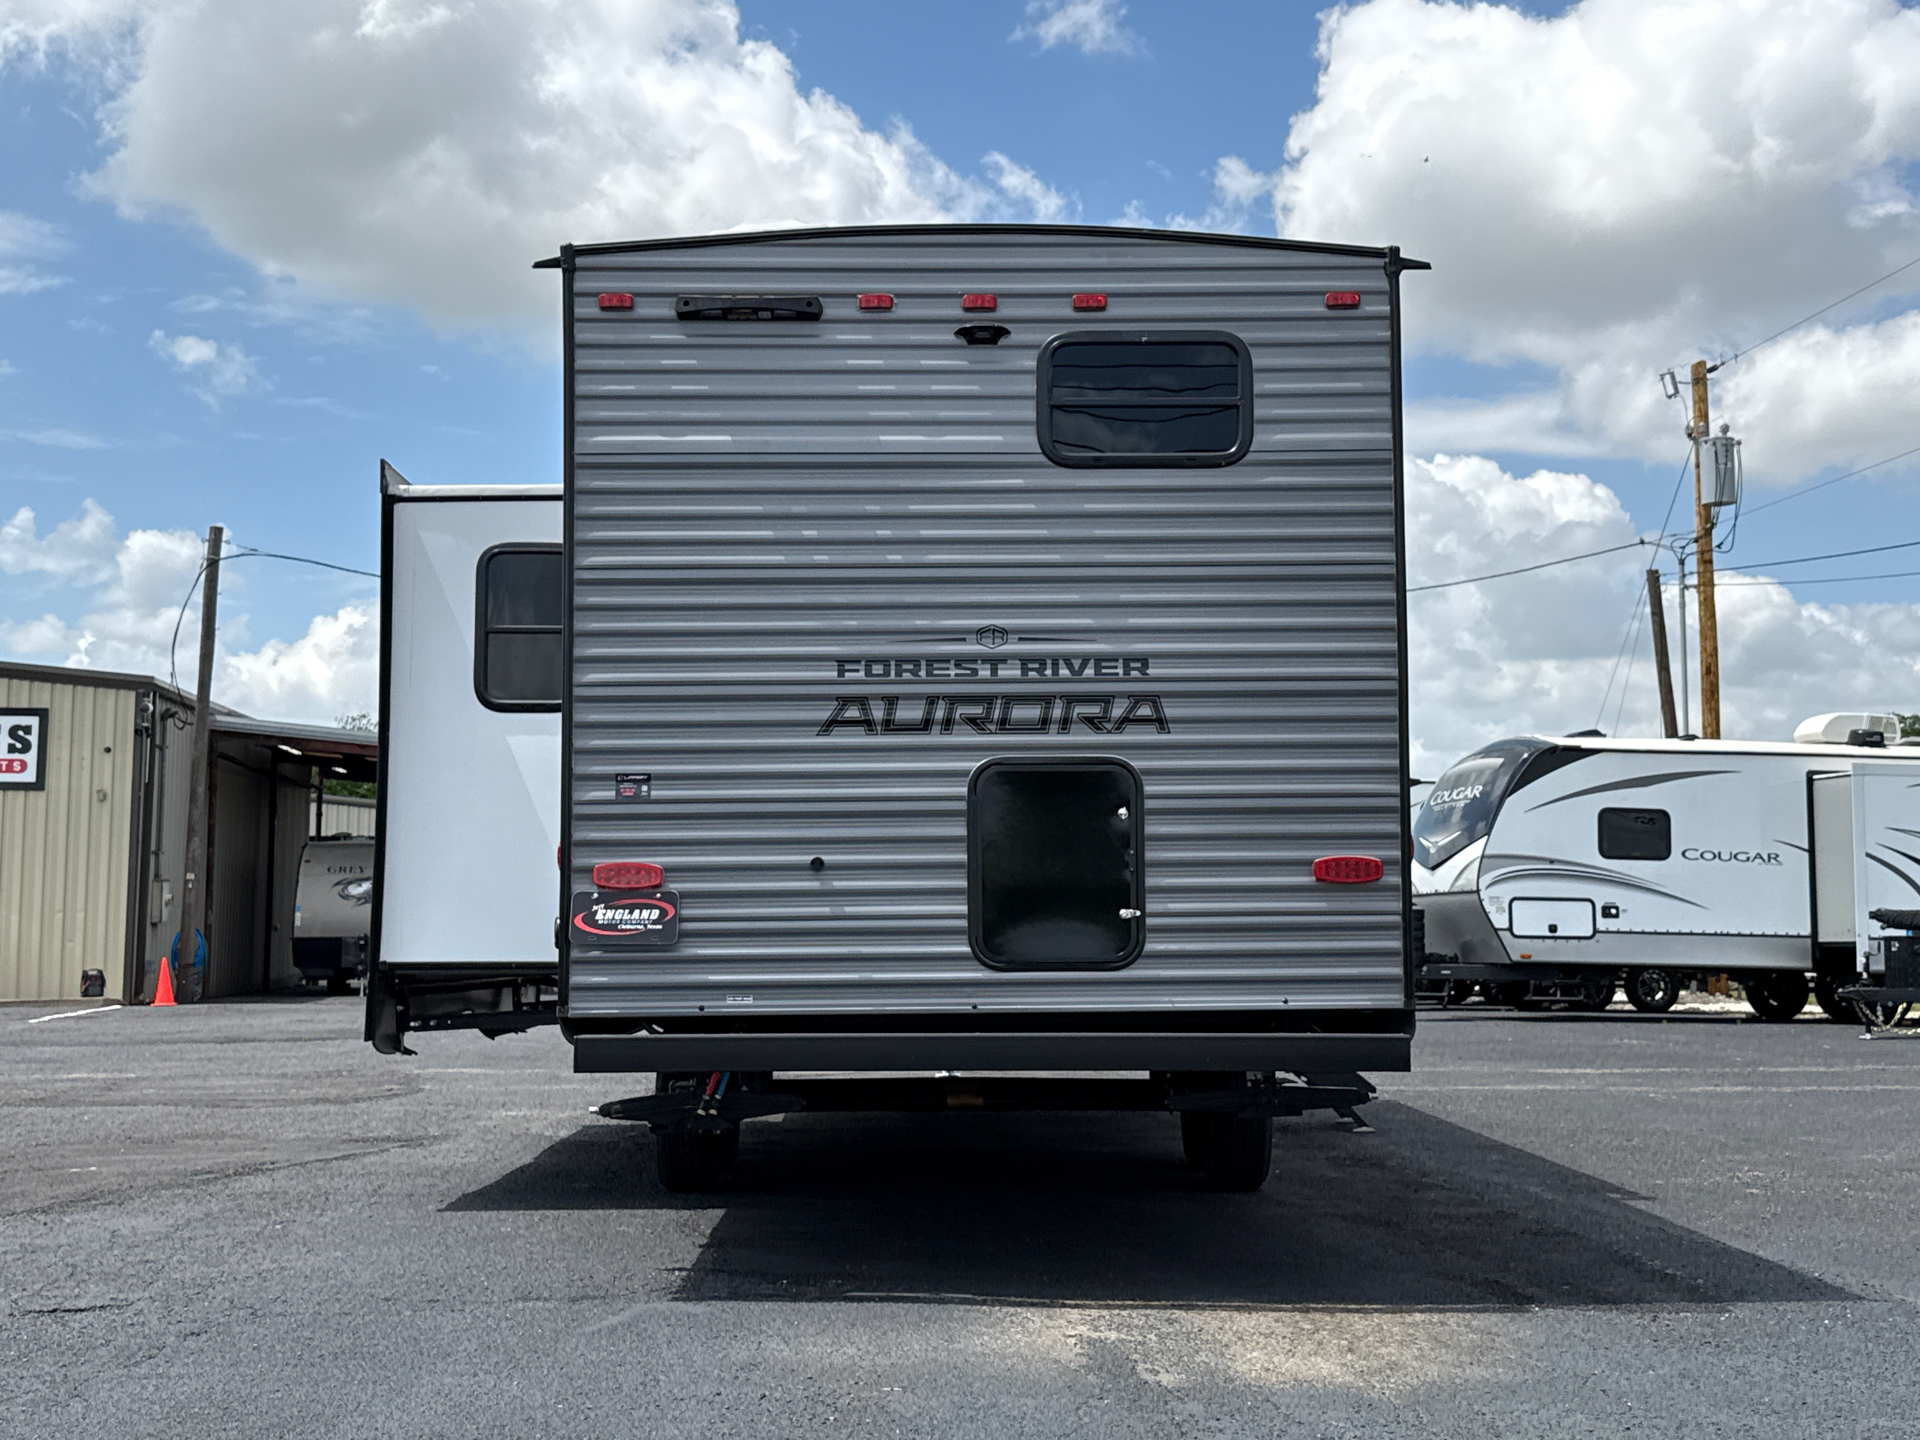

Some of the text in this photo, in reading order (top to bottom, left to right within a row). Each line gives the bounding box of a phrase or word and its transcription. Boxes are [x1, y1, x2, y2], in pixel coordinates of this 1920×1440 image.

[834, 657, 1151, 679] FOREST RIVER
[816, 694, 1172, 736] AURORA
[1429, 784, 1484, 806] COUGAR
[1680, 847, 1783, 864] COUGAR
[327, 865, 367, 874] GREY
[595, 908, 660, 920] ENGLAND
